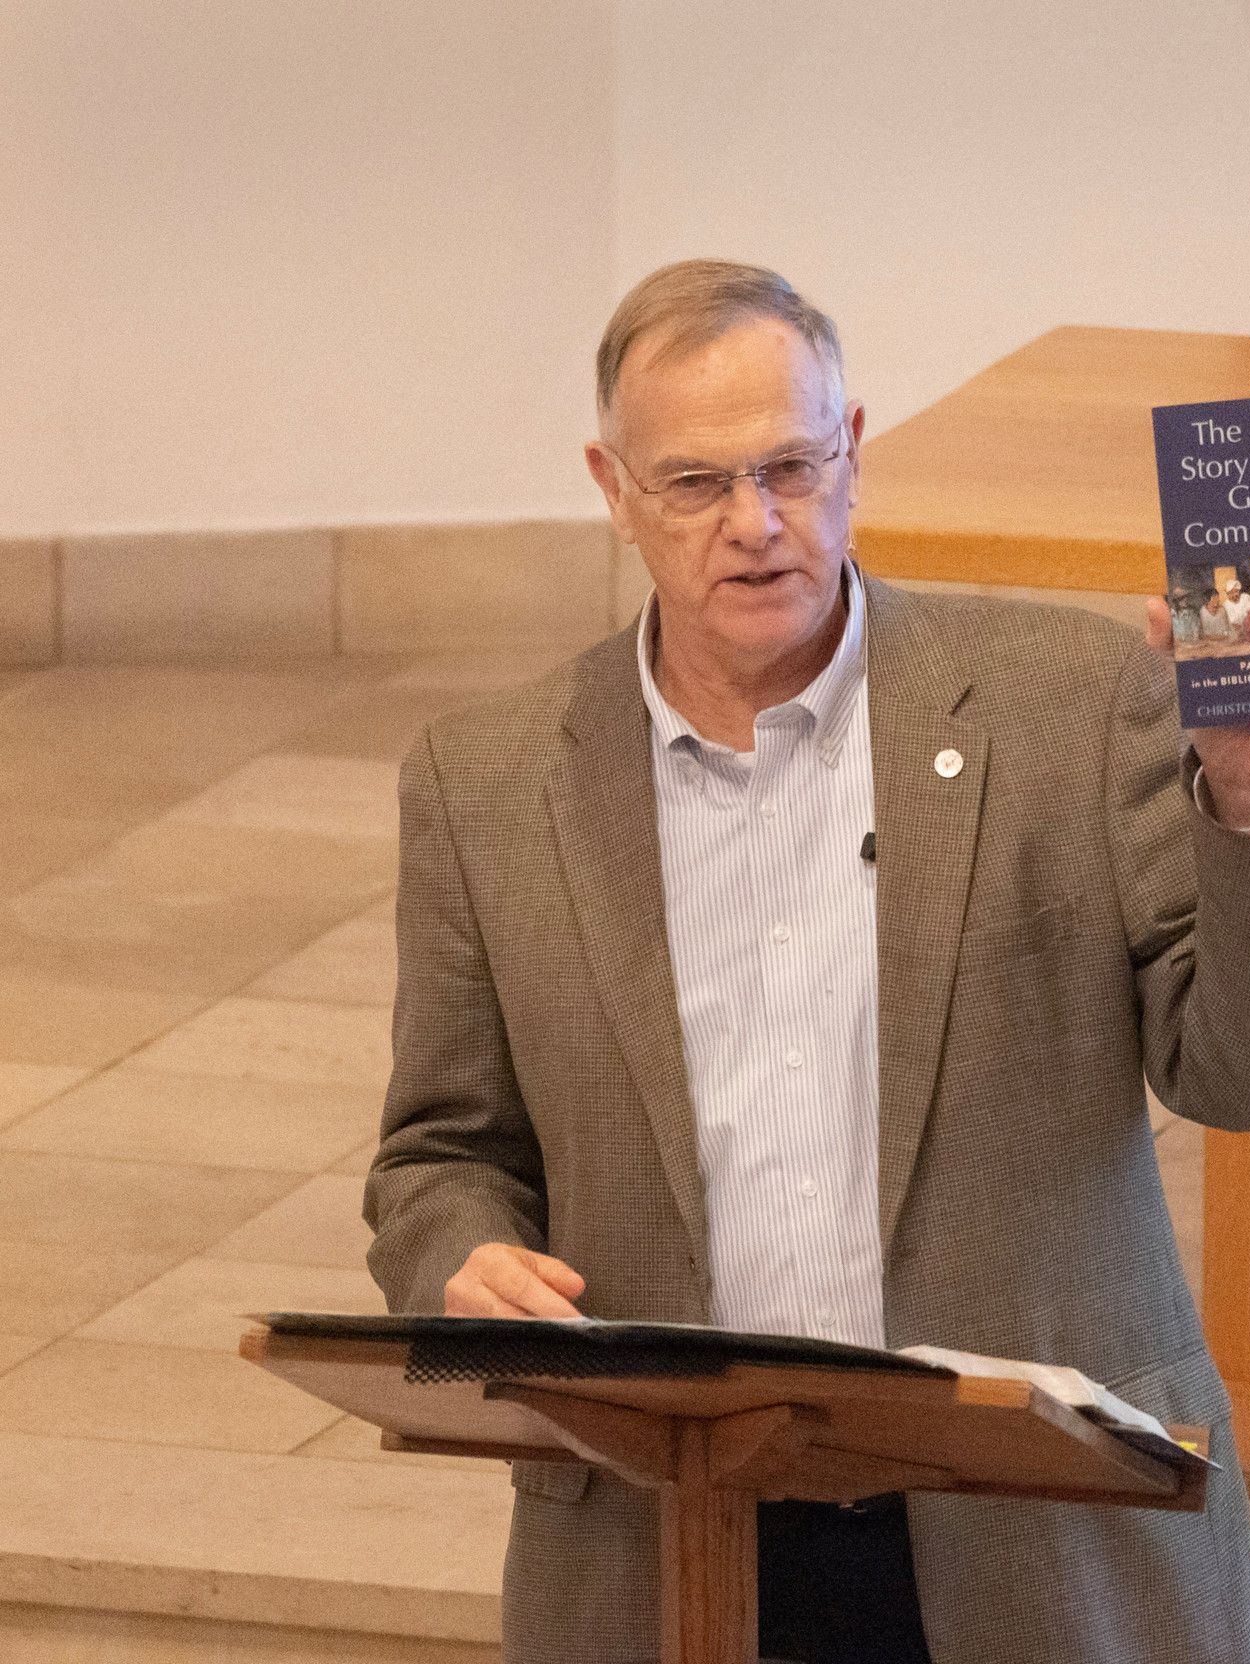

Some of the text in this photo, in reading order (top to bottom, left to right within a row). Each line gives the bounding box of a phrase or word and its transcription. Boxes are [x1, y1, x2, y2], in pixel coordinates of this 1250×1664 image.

[1191, 418, 1242, 446] The
[1180, 455, 1249, 484] Story
[1191, 679, 1201, 689] in
[1202, 677, 1218, 688] the
